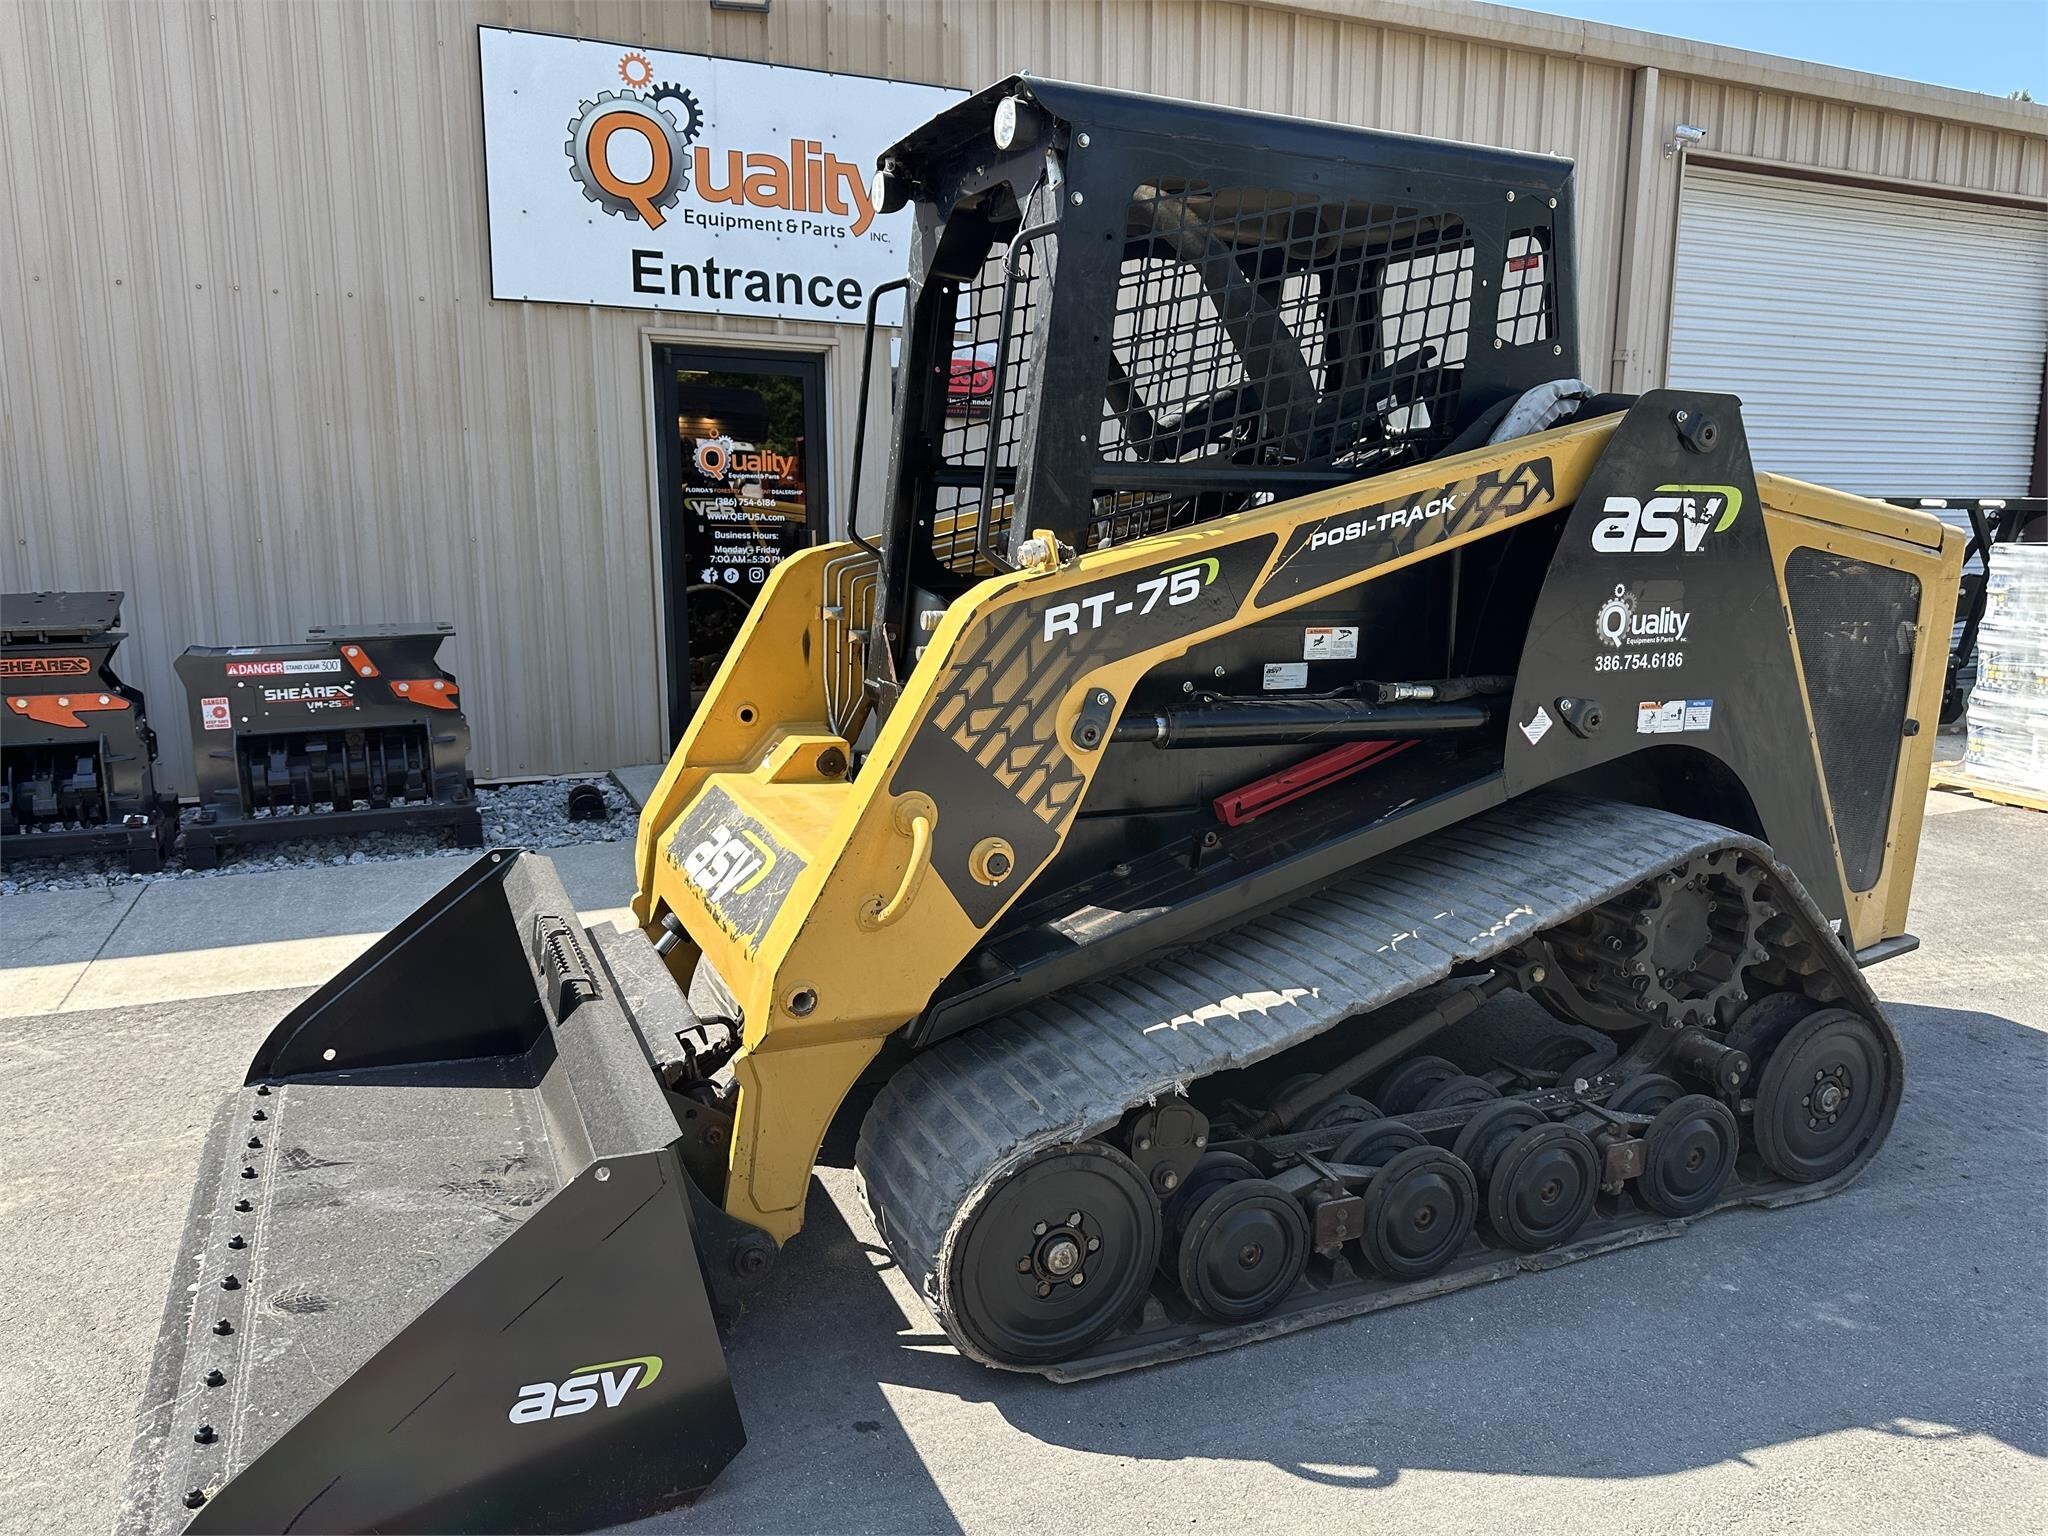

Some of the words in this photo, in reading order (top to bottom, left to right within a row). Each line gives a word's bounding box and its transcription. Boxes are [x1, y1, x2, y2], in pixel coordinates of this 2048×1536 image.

[587, 109, 877, 238] Quality
[684, 209, 783, 231] Equipment
[787, 219, 799, 234] &
[801, 220, 846, 239] Parts
[870, 232, 891, 243] INC.
[631, 248, 863, 310] Entrance
[700, 446, 794, 480] Quality
[728, 472, 760, 481] Equipment
[685, 486, 714, 494] FLORIDA'S
[715, 498, 738, 508] (386)
[739, 498, 777, 508] 754-6186
[706, 512, 785, 522] www.QEPUSA.com
[1310, 494, 1458, 551] POSI-TRACK
[1591, 497, 1723, 553] asv
[714, 531, 752, 539] Business
[752, 532, 779, 540] Hours:
[710, 555, 730, 563] 7:00
[752, 556, 771, 564] 5:30
[714, 545, 748, 555] Monday
[755, 546, 780, 555] Friday
[1043, 567, 1201, 643] RT-75
[1602, 606, 1690, 648] Quality
[1626, 637, 1656, 645] Equipment
[238, 662, 284, 675] DANGER
[1594, 651, 1684, 672] 386.754.6186
[264, 684, 354, 701] SHEAREX
[684, 824, 763, 903] asv
[508, 1365, 642, 1425] asv
